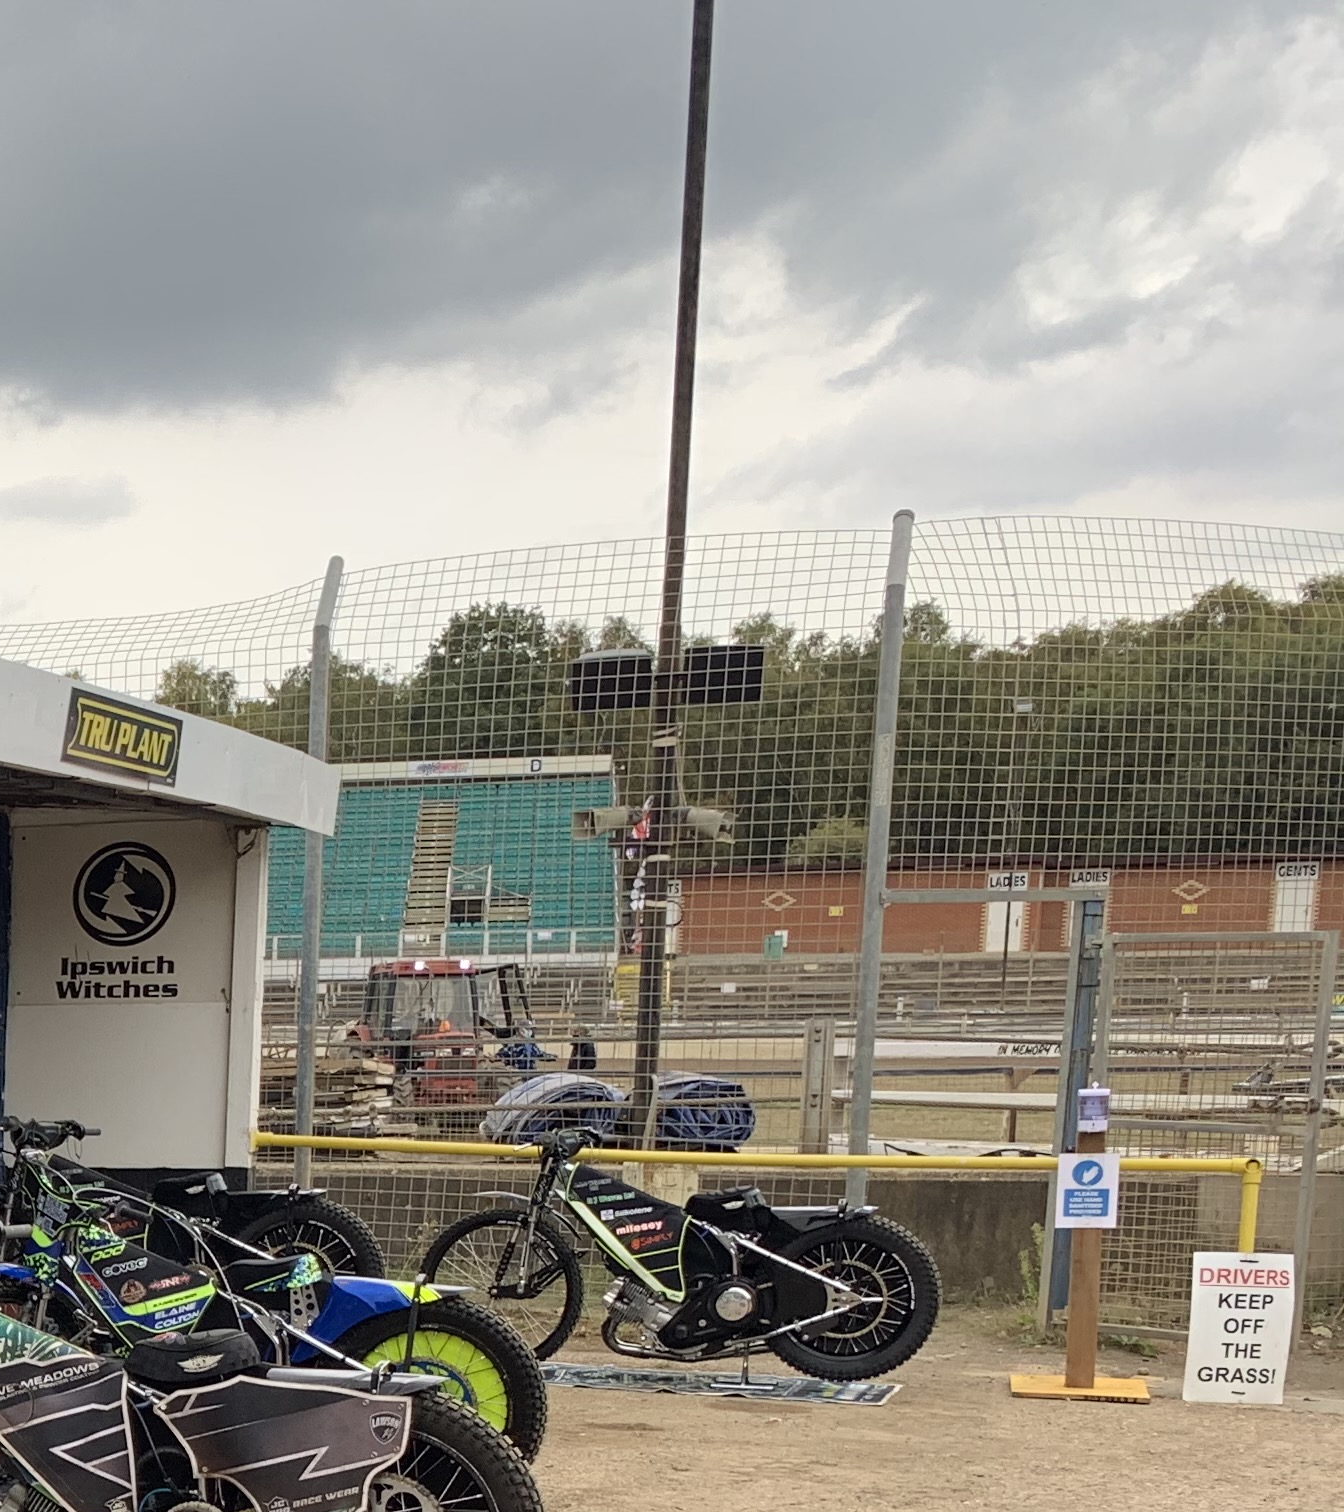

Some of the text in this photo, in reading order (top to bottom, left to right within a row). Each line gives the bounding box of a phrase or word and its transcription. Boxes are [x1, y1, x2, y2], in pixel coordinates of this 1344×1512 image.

[79, 711, 172, 766] TRU PLANT
[530, 759, 542, 772] D
[1071, 870, 1109, 884] LADIES
[1278, 864, 1317, 878] GENTS
[56, 955, 178, 999] Ipswich Witches
[1199, 1268, 1290, 1286] DRIVERS
[154, 1301, 197, 1320] ELAINE
[1218, 1293, 1274, 1310] KEEP
[155, 1311, 200, 1330] COLTON
[1223, 1318, 1265, 1334] OFF
[1221, 1343, 1262, 1359] THE
[20, 1361, 100, 1389] MEADOWS
[1197, 1366, 1276, 1385] GRASS!
[292, 1486, 359, 1508] RACE WEAR
